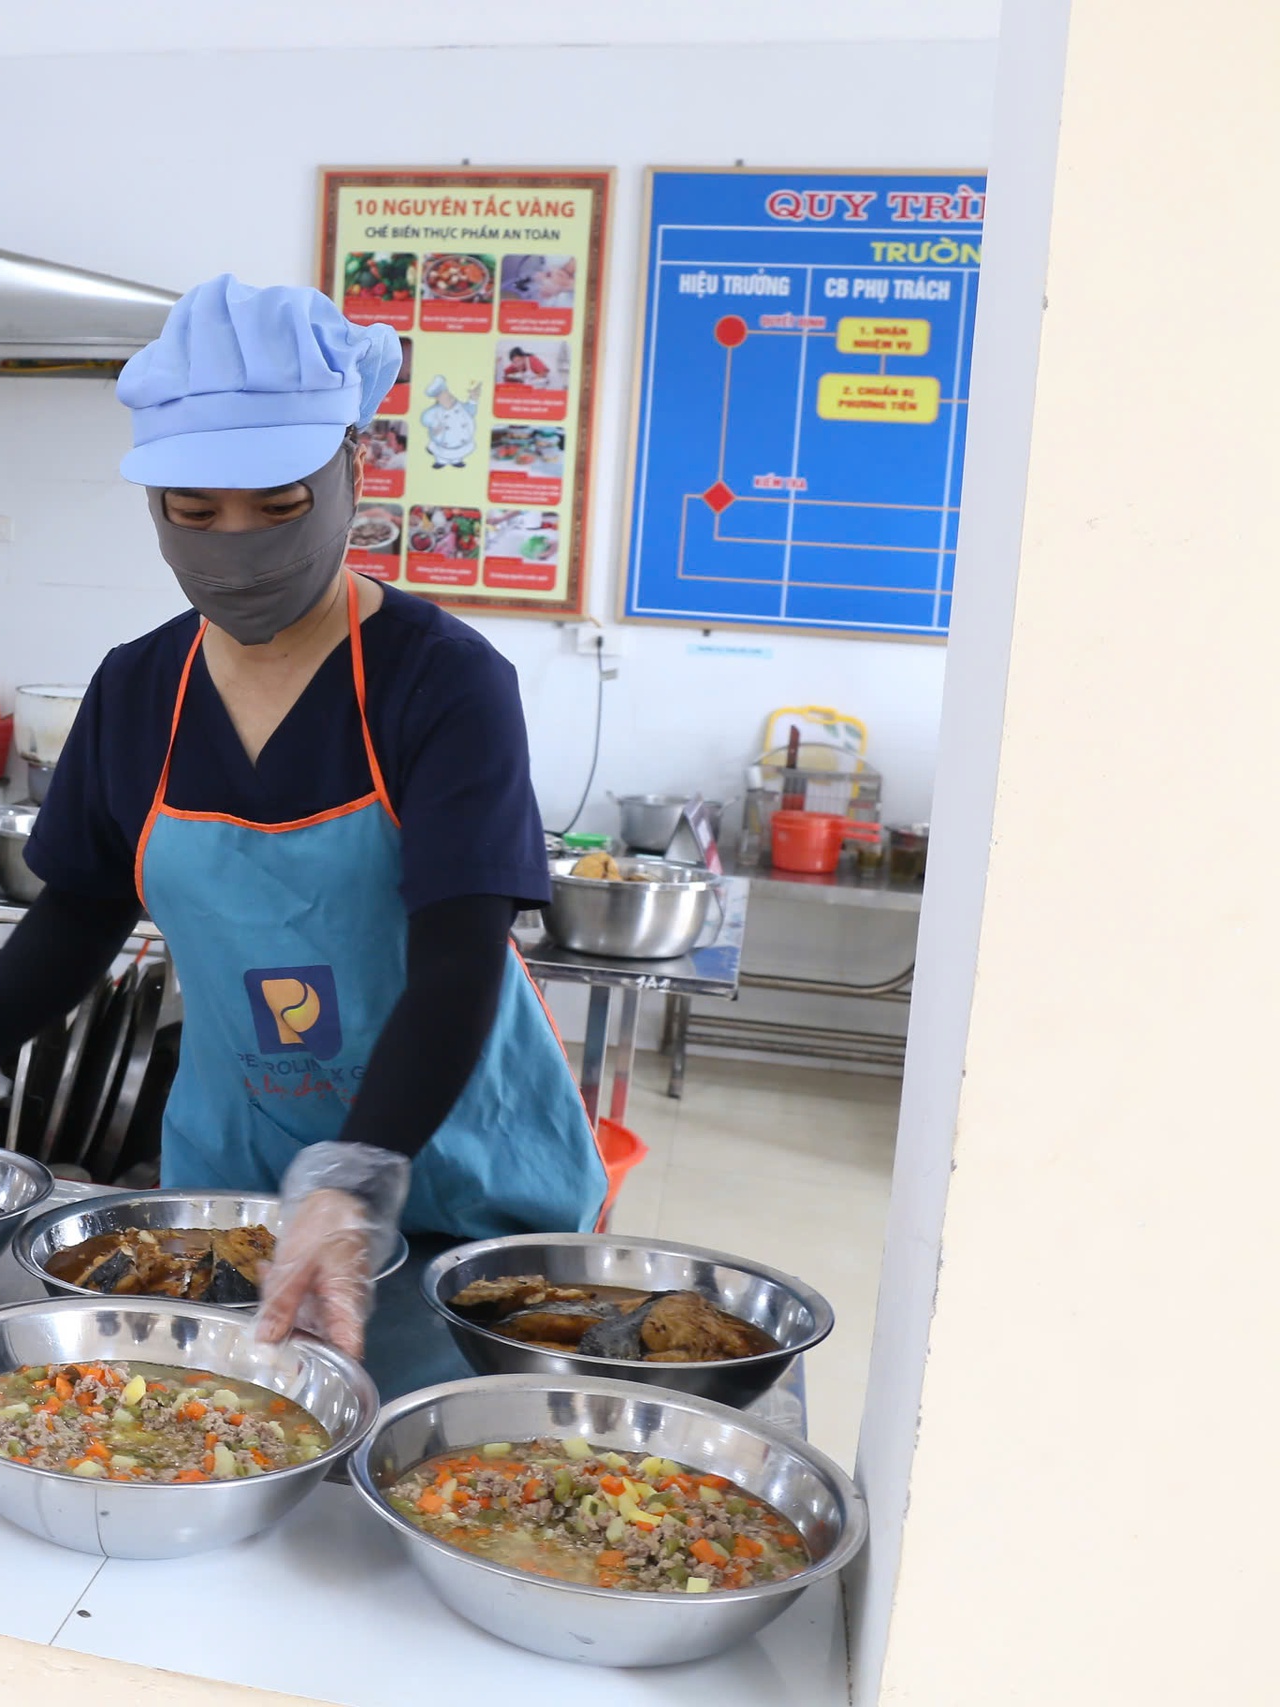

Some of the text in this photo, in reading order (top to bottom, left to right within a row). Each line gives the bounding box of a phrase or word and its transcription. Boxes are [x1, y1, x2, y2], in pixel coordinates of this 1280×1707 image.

[355, 194, 576, 219] 10 NGUYÊN TẮC VÀNG
[766, 190, 877, 222] QUY
[365, 225, 388, 239] CHẾ
[391, 225, 420, 239] BIẾN
[423, 227, 458, 241] THỰC
[503, 229, 521, 240] AN
[525, 226, 561, 241] TOÀN
[870, 237, 983, 265] TRƯỜN
[678, 268, 791, 299] HIỆU TRƯỞNG
[824, 276, 951, 304] CB PHỤ TRÁCH
